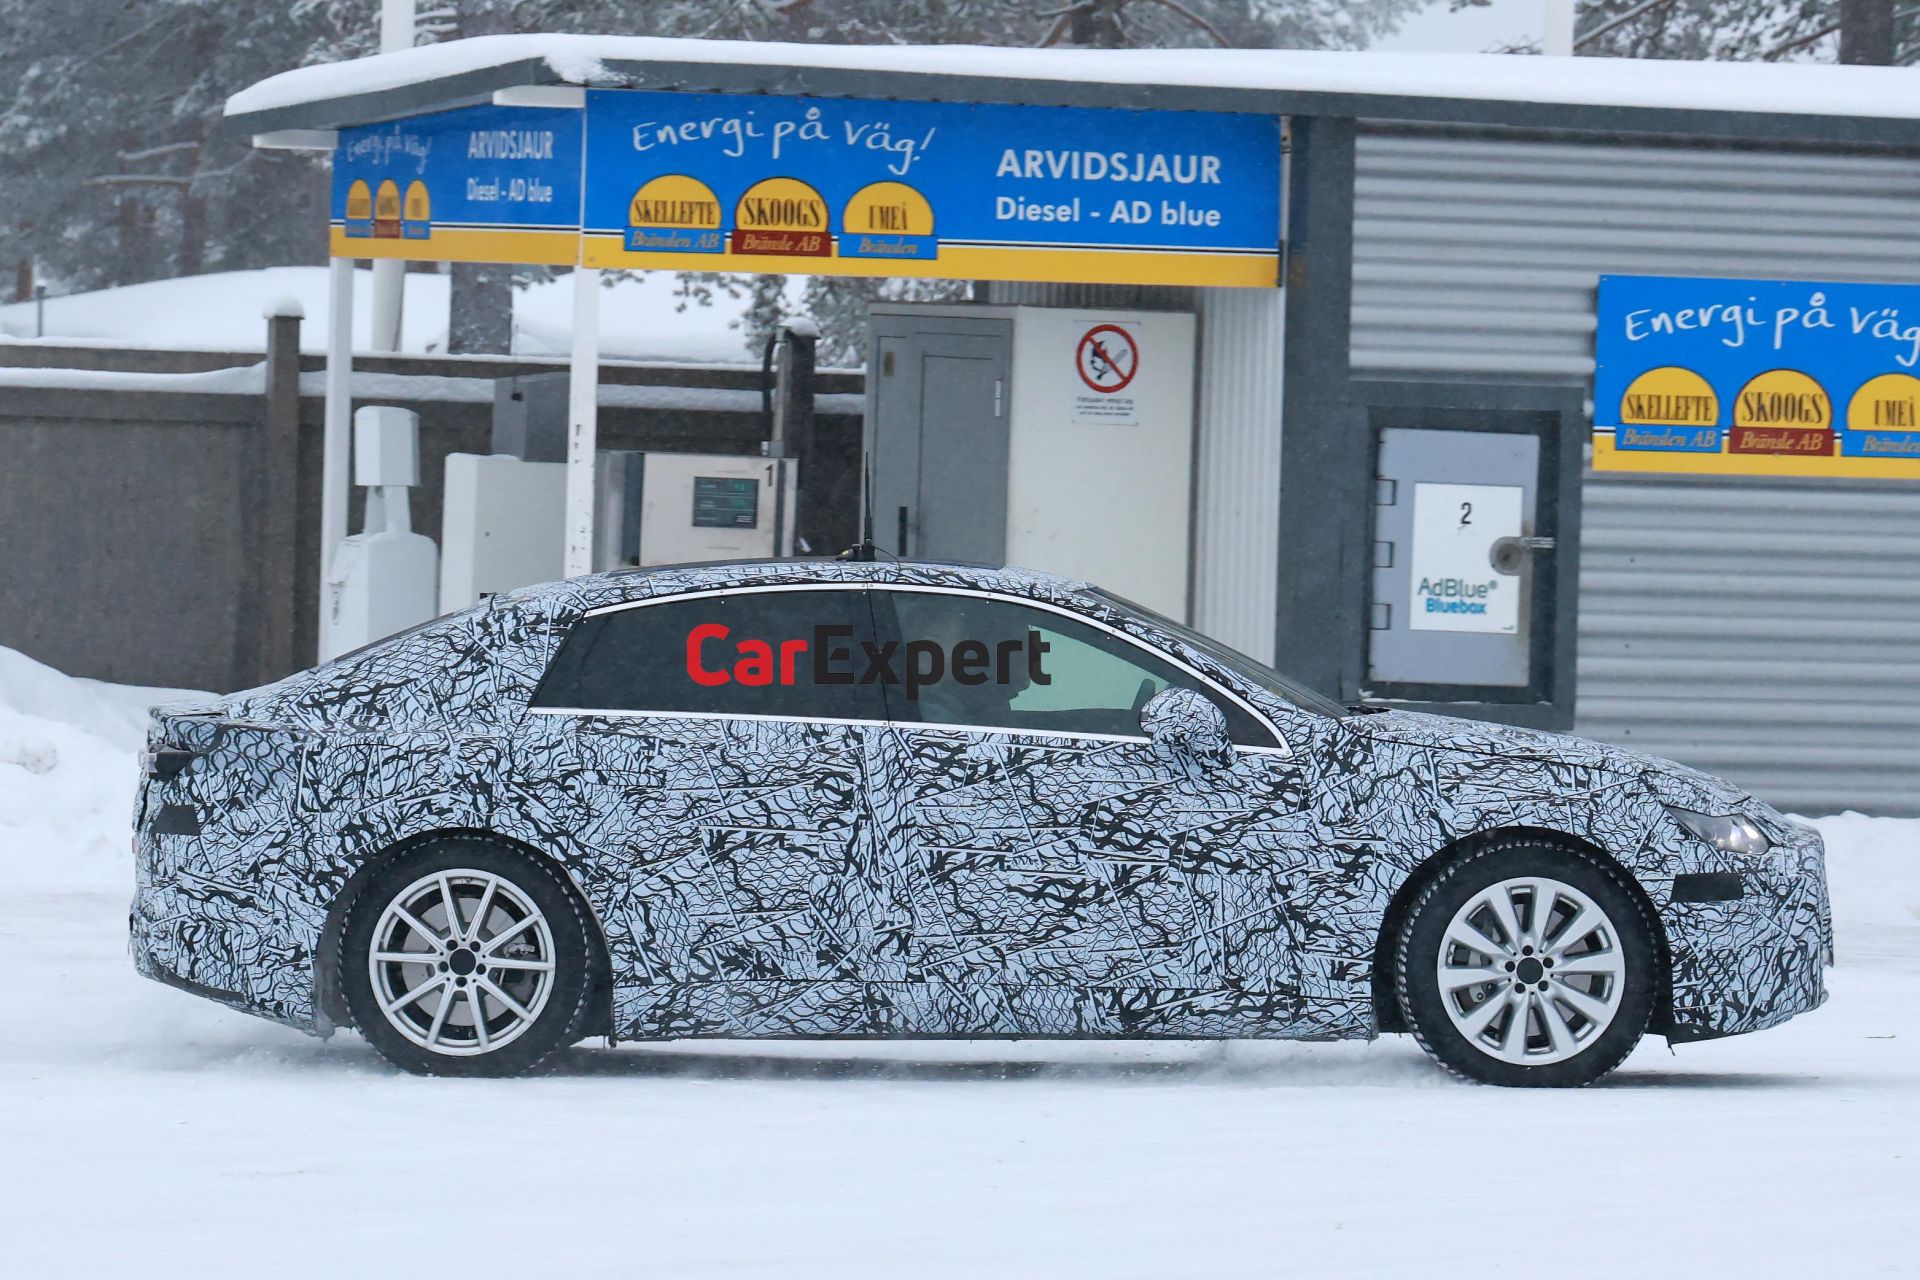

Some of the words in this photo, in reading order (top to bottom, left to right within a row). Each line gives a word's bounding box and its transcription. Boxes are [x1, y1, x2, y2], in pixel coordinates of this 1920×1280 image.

[467, 131, 554, 160] ARVIDSJAUR
[632, 110, 765, 157] Energi
[772, 107, 830, 159] på
[996, 149, 1221, 184] ARVIDSJAUR
[467, 177, 500, 201] Diesel
[508, 178, 526, 201] AD
[527, 177, 553, 203] blue
[635, 200, 716, 225] SKELLEFTE
[743, 197, 820, 227] SKOOGS
[996, 196, 1080, 222] Diesel
[1109, 200, 1151, 224] AD
[1161, 200, 1221, 227] blue
[694, 233, 719, 249] AB
[794, 236, 820, 253] AB
[1625, 296, 1766, 347] Energi
[1774, 291, 1835, 350] på
[1626, 394, 1713, 422] SKELLEFTE
[1742, 392, 1823, 424] SKOOGS
[1689, 431, 1717, 449] AB
[1795, 431, 1824, 451] AB
[765, 464, 774, 487] 1
[1460, 502, 1472, 524] 2
[1426, 598, 1487, 614] Bluebox
